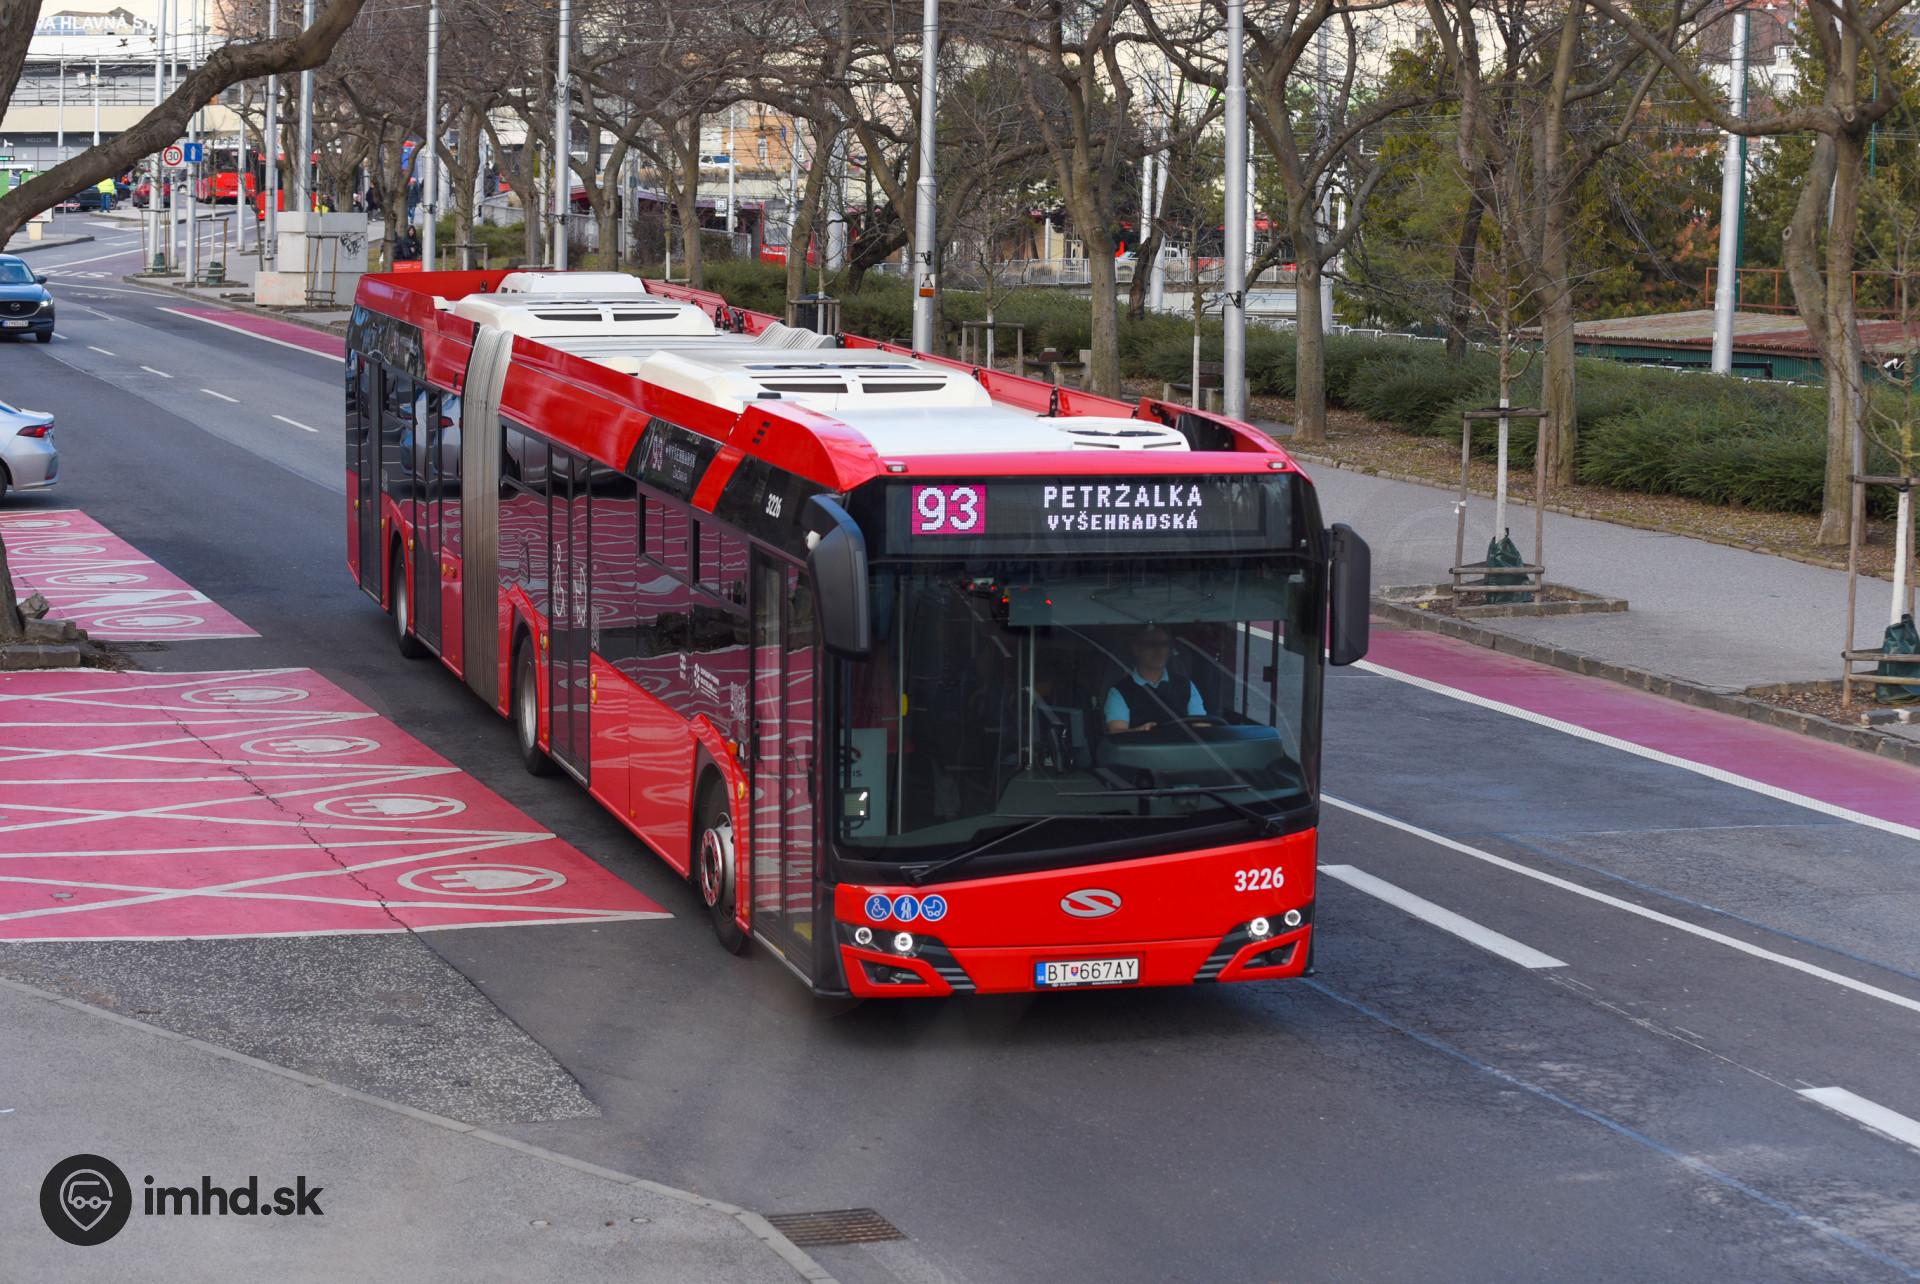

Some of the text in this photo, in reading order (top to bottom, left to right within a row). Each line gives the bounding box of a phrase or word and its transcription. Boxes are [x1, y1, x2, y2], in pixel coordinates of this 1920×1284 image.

[61, 13, 128, 30] HLAVNÁ
[167, 151, 179, 161] 30
[765, 492, 782, 519] 3226
[1044, 484, 1202, 508] PETRŽALKA
[918, 487, 978, 531] 93
[1048, 509, 1198, 531] VYŠEHRADSKÁ
[1234, 866, 1284, 892] 3226
